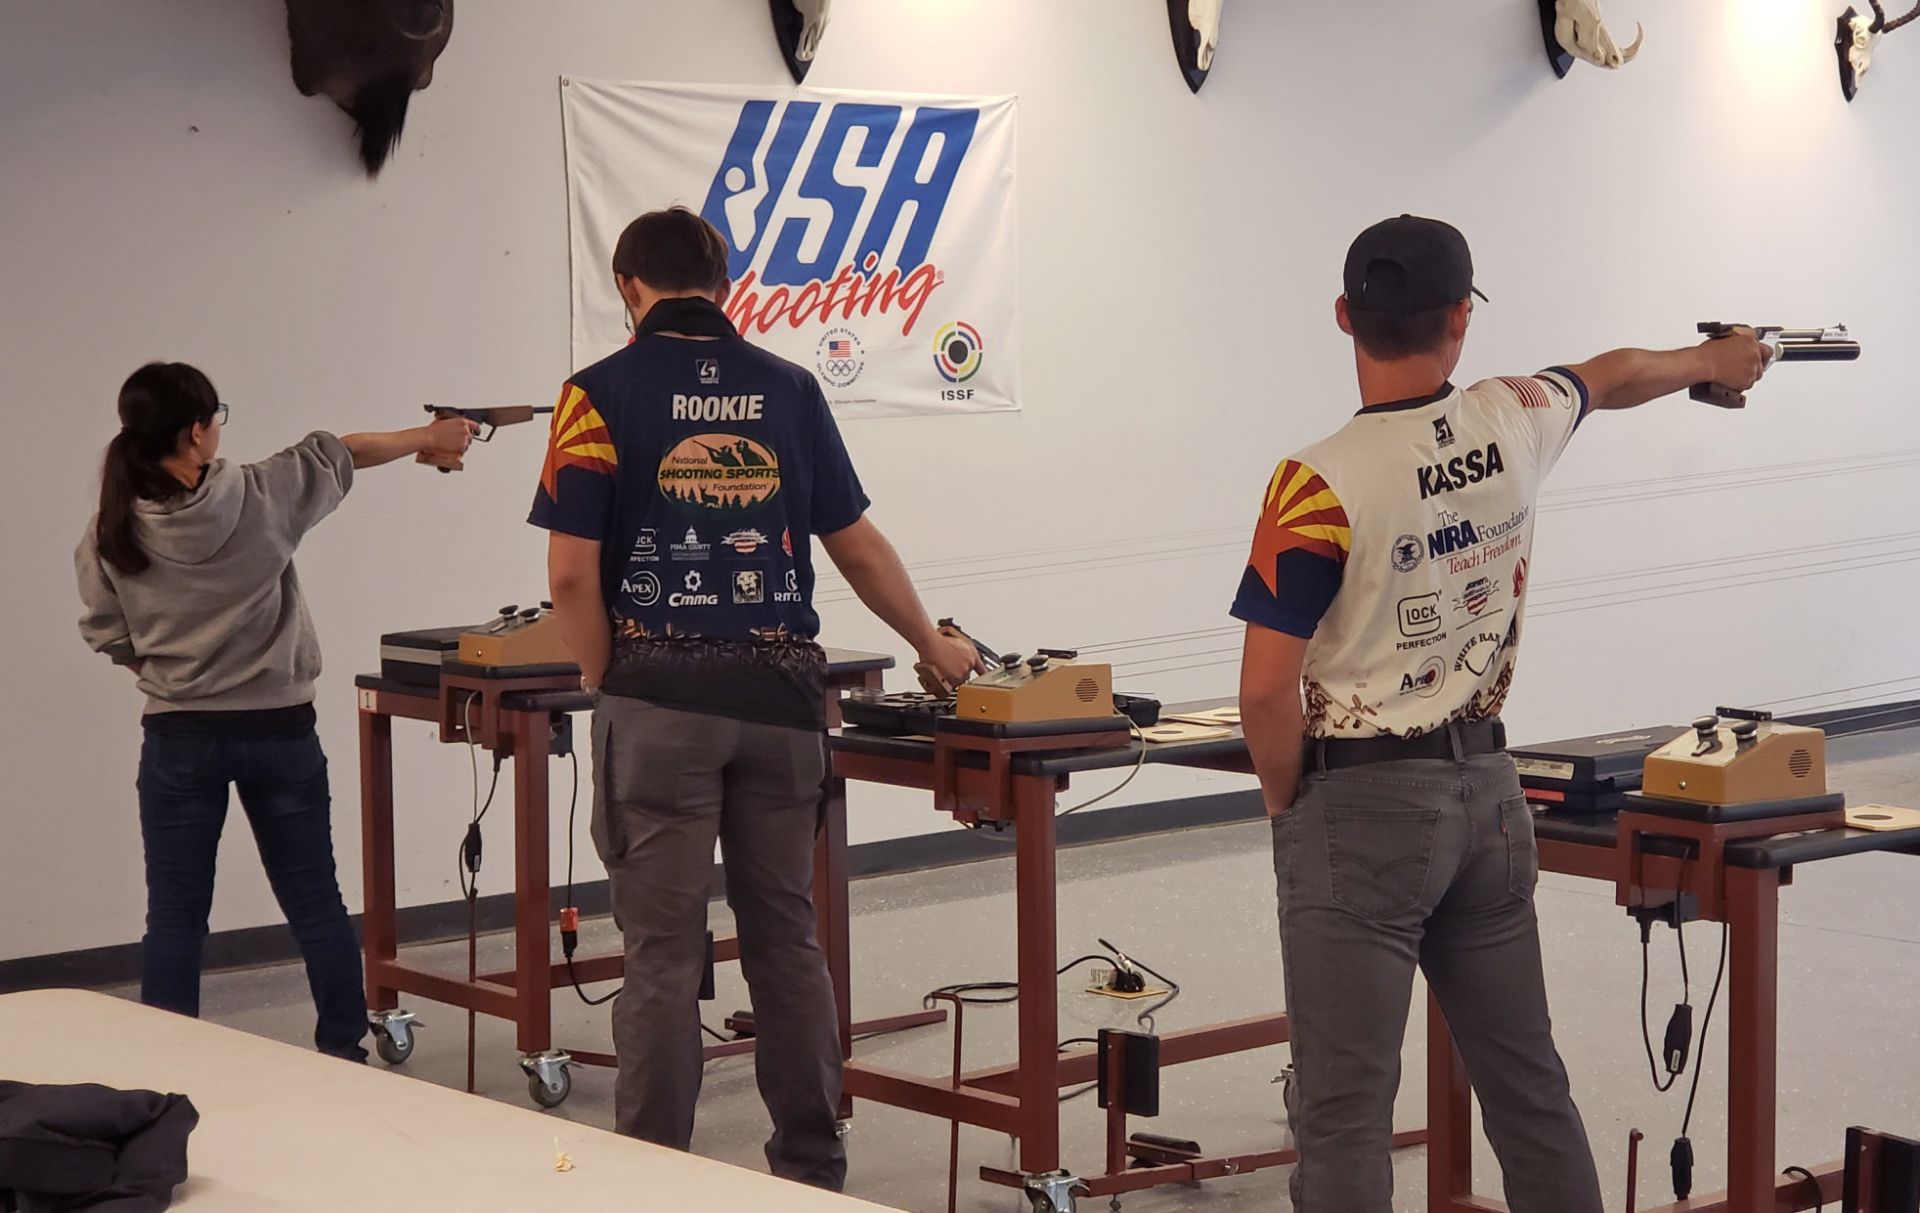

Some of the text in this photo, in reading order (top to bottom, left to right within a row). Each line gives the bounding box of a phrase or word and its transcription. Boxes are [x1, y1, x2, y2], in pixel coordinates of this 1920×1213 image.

[700, 100, 980, 286] USA
[724, 264, 944, 337] hooting
[941, 389, 974, 401] ISSF
[672, 394, 764, 421] ROOKIE
[671, 456, 708, 465] National
[1417, 441, 1504, 500] KASSA
[659, 467, 780, 480] SHOOTING SPORTS
[712, 482, 766, 491] Foundation
[1438, 510, 1458, 527] The
[1427, 520, 1479, 560] NRA
[1447, 553, 1480, 575] Teach
[1396, 632, 1447, 651] PERFECTION
[1454, 635, 1478, 672] WHITE
